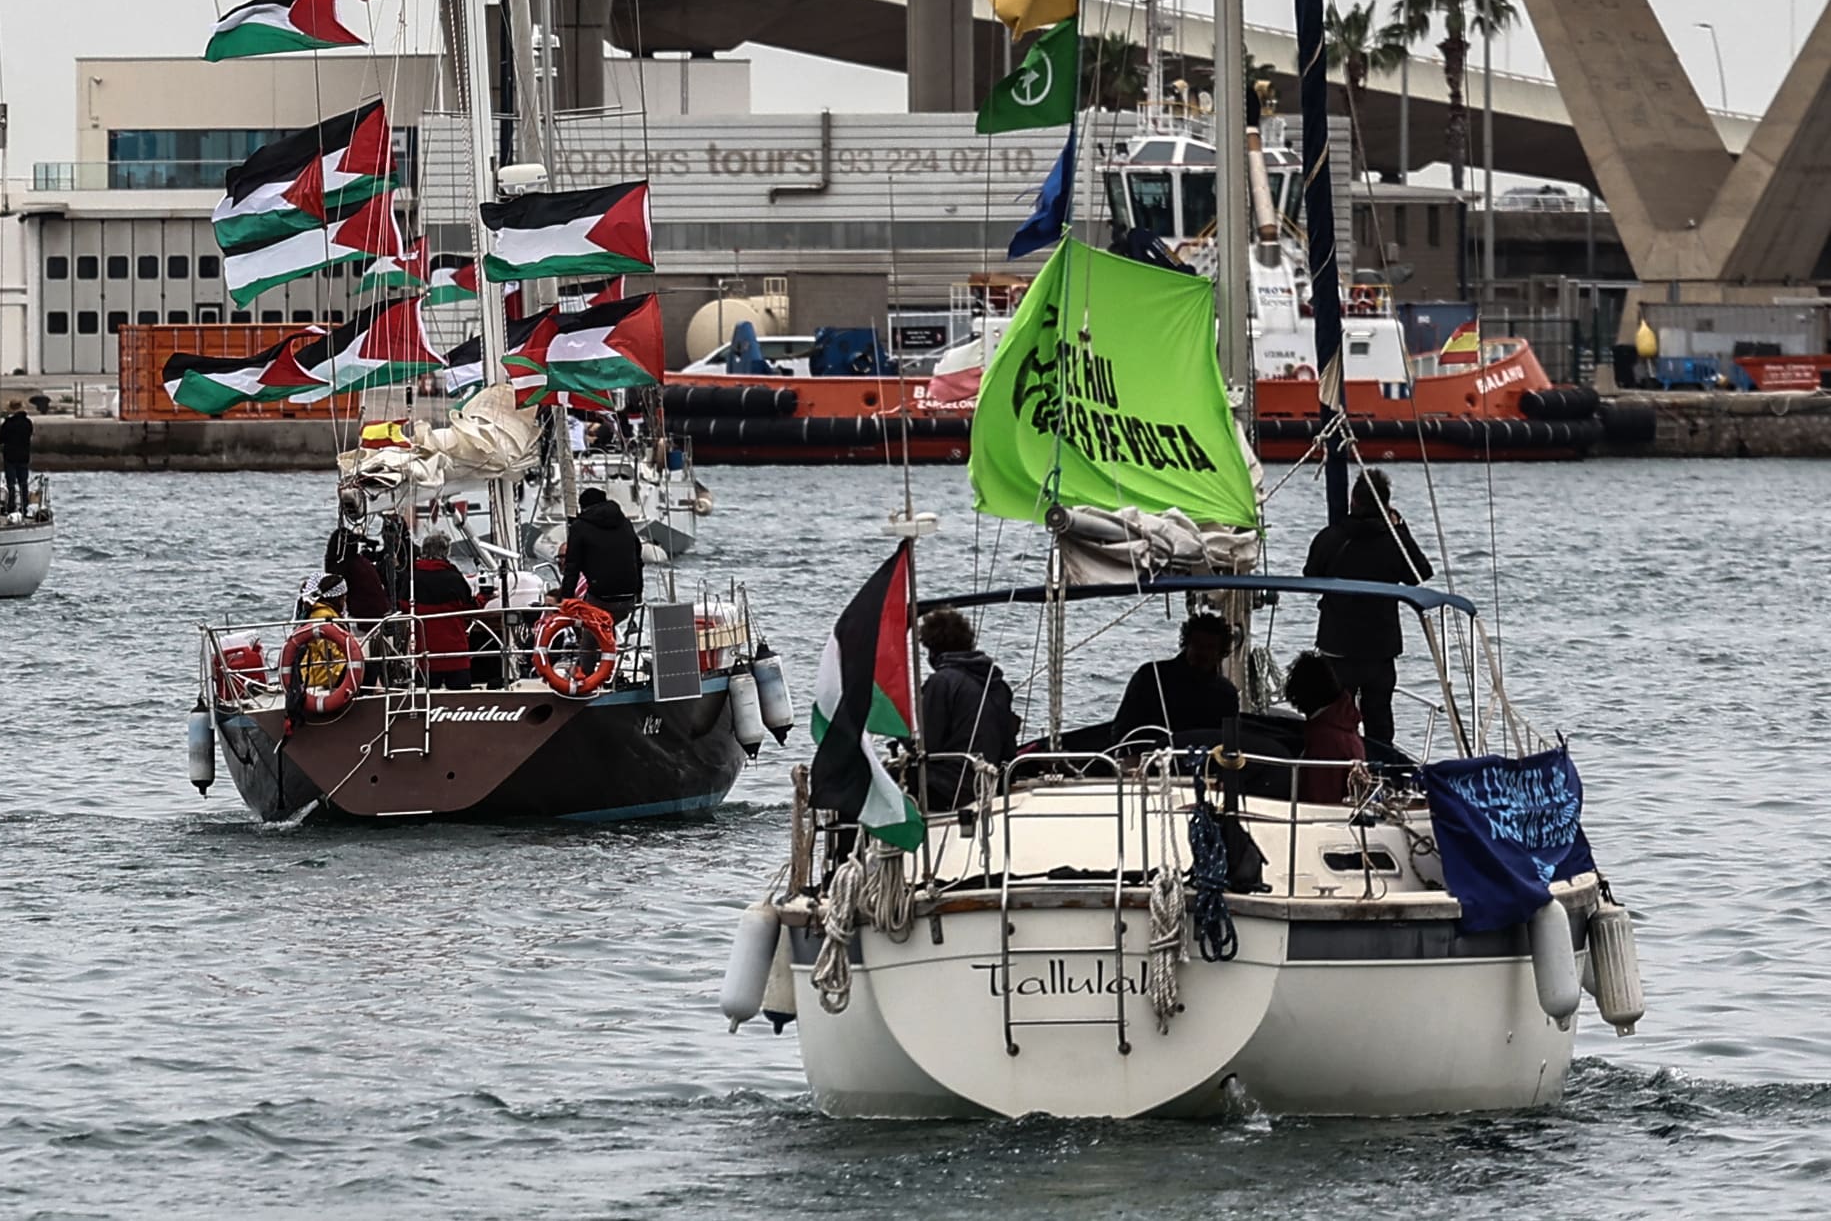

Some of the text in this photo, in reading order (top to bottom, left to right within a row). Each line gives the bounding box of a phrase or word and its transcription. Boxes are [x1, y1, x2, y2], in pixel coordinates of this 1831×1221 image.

[707, 142, 818, 176] tours
[839, 148, 874, 175] 93
[886, 148, 941, 175] 224
[950, 148, 986, 176] 07
[999, 146, 1035, 176] 10
[430, 705, 527, 723] Trinidad
